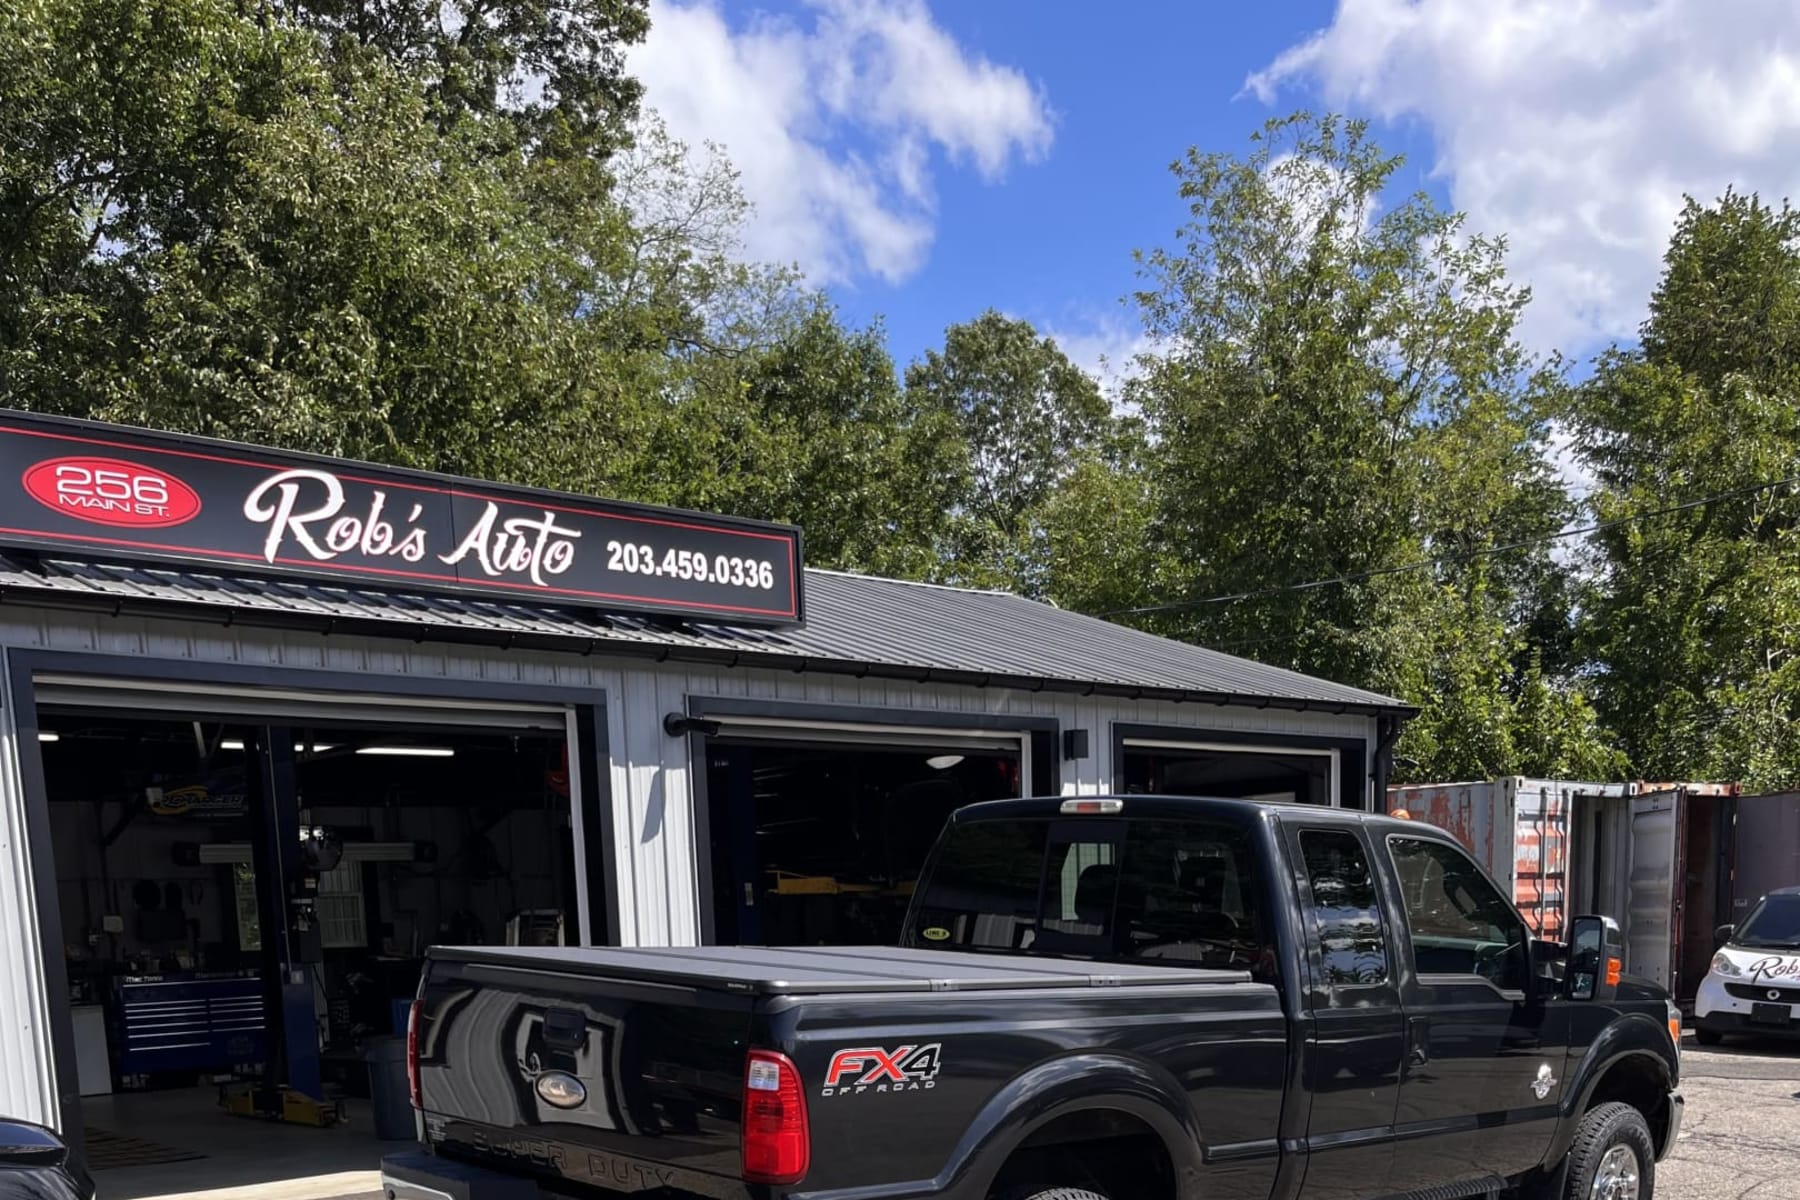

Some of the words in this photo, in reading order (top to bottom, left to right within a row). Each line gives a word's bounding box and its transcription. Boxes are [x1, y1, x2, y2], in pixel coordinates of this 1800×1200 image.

[56, 466, 168, 504] 256
[59, 493, 130, 513] MAIN
[135, 503, 170, 518] ST.
[243, 469, 427, 564] Rob's
[438, 501, 582, 586] Auto
[606, 540, 774, 590] 203.459.0336
[1749, 956, 1800, 984] Rob
[823, 1043, 942, 1088] FX4
[821, 1085, 867, 1097] OFF
[876, 1080, 936, 1093] ROAD
[586, 1154, 674, 1190] DUTY
